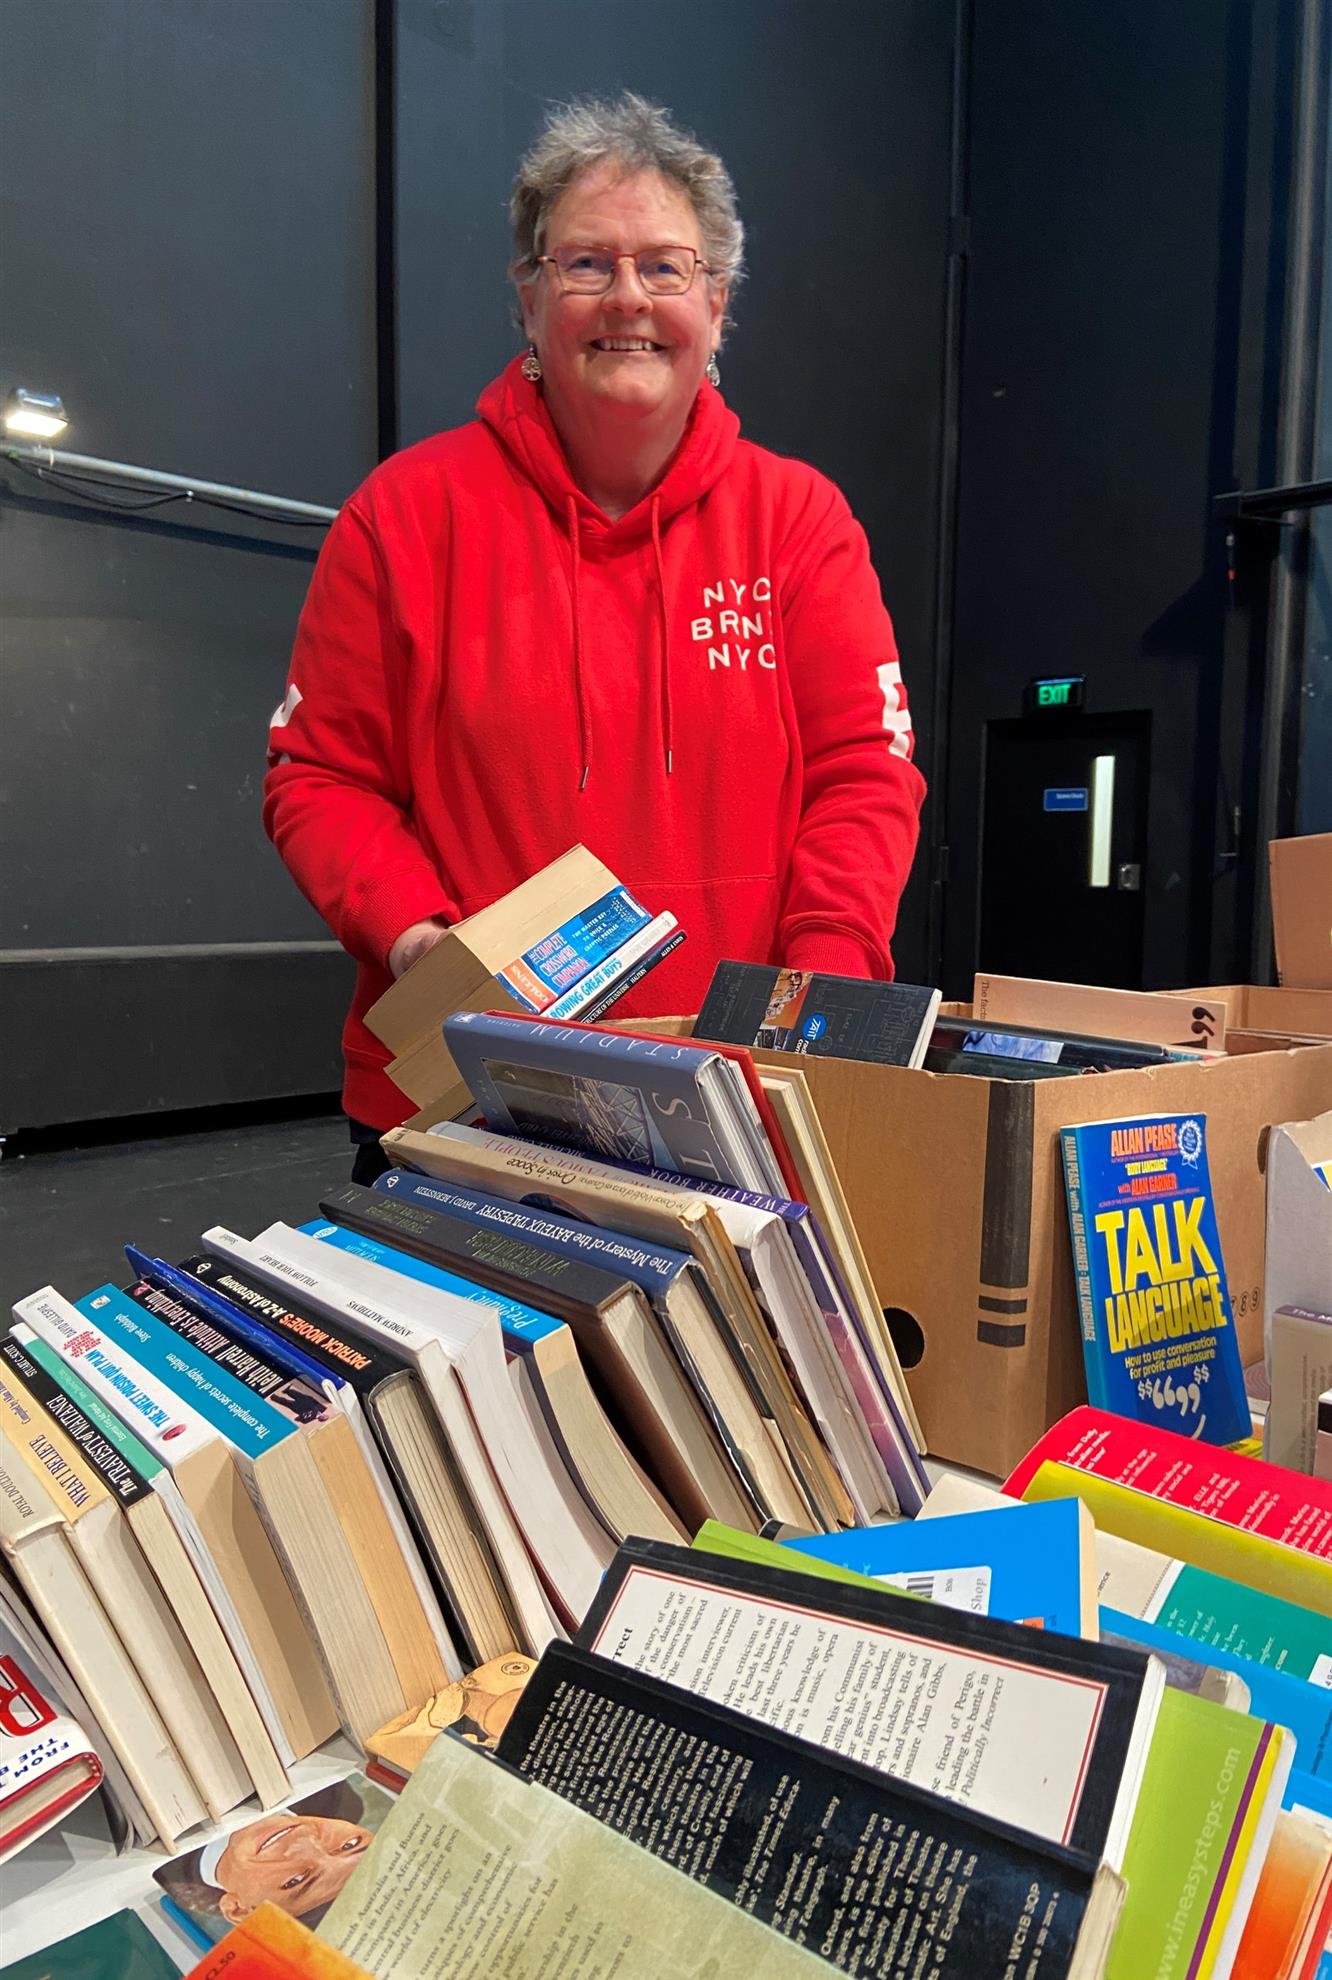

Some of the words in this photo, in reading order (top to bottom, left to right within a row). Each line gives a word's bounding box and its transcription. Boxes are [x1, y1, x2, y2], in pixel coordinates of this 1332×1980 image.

[703, 577, 771, 608] NYC
[690, 610, 773, 641] BRN
[708, 643, 776, 671] NYC
[1039, 683, 1072, 706] EXIT
[534, 933, 568, 960] COMPLETE
[511, 964, 549, 1003] COLLINS
[549, 990, 584, 1019] ROWING
[581, 974, 605, 996] GREAT
[583, 1006, 603, 1026] TRUCTURE
[525, 1023, 691, 1059] STADIUM
[1064, 1135, 1077, 1161] ALLAN
[1111, 1128, 1144, 1157] ALLAN
[1144, 1123, 1178, 1152] PEASE
[502, 1155, 538, 1175] Space
[532, 1164, 548, 1177] in
[643, 1168, 693, 1188] BOOK
[1067, 1161, 1080, 1188] PEASE
[412, 1185, 452, 1202] BERNSTEIN
[692, 1180, 779, 1211] WEATHER
[1118, 1183, 1131, 1194] with
[1131, 1177, 1149, 1195] ALAN
[1149, 1173, 1177, 1193] GARNER
[453, 1197, 477, 1210] DAVID
[1070, 1189, 1081, 1211] with
[474, 1203, 531, 1228] TAPESTRY
[1072, 1212, 1084, 1235] ALAN
[523, 1218, 575, 1242] BAYEUX
[568, 1232, 593, 1248] the
[583, 1236, 605, 1252] of
[598, 1240, 653, 1266] Mystery
[1075, 1236, 1088, 1271] GARNER
[1095, 1196, 1218, 1295] TALK
[258, 1254, 281, 1267] HEART
[275, 1263, 295, 1275] YOUR
[644, 1255, 676, 1274] The
[213, 1273, 266, 1304] Astronomy
[289, 1271, 318, 1286] FOLLOW
[1078, 1276, 1091, 1297] TALK
[36, 1302, 65, 1326] GILLESPIE
[138, 1285, 195, 1327] Everything
[251, 1297, 272, 1310] of
[345, 1300, 385, 1322] MATTHEWS
[457, 1288, 541, 1331] Pregnancy
[1105, 1274, 1228, 1354] LANGUAGE
[56, 1321, 77, 1338] DAVID
[111, 1310, 141, 1333] Biddulph
[174, 1314, 199, 1333] is
[276, 1312, 330, 1344] MOORE'S
[380, 1319, 413, 1337] ANDREW
[1081, 1297, 1096, 1342] LANGUAGE
[130, 1327, 151, 1343] Steve
[181, 1319, 230, 1356] Attitude
[83, 1348, 108, 1367] PLAN
[162, 1352, 190, 1374] children
[213, 1342, 261, 1377] Harrell
[319, 1337, 372, 1369] PATRICK
[1125, 1355, 1142, 1370] How
[1143, 1352, 1152, 1364] to
[1152, 1348, 1166, 1361] use
[1167, 1336, 1217, 1357] conversation
[1130, 1366, 1141, 1380] for
[1143, 1361, 1166, 1378] profit
[1166, 1357, 1181, 1371] and
[1182, 1348, 1216, 1369] pleasure
[15, 1357, 38, 1378] STUART
[95, 1358, 123, 1379] QUIT
[182, 1365, 209, 1387] happy
[242, 1363, 284, 1394] Keith
[107, 1372, 140, 1397] POISON
[197, 1380, 213, 1392] of
[205, 1386, 232, 1407] secrets
[44, 1392, 92, 1437] WAITANGI
[127, 1390, 159, 1416] SWEET
[223, 1399, 261, 1428] complete
[146, 1408, 172, 1427] THE
[250, 1422, 272, 1439] The
[75, 1428, 96, 1444] of
[27, 1433, 68, 1475] BELIEVE
[80, 1433, 132, 1483] TRAVESTY
[54, 1467, 71, 1480] I
[114, 1476, 138, 1496] The
[57, 1471, 93, 1507] WHAT
[10, 1493, 34, 1519] ROYAL
[969, 1577, 987, 1610] Shop
[631, 1653, 647, 1671] the
[641, 1626, 661, 1651] story
[655, 1611, 666, 1622] of
[661, 1591, 676, 1608] one
[647, 1646, 662, 1663] the
[657, 1609, 681, 1642] danger
[675, 1592, 687, 1604] of
[656, 1605, 694, 1669] conservatism
[675, 1632, 694, 1657] most
[687, 1599, 709, 1630] sacred
[697, 1605, 733, 1663] interviewer,
[695, 1644, 728, 1696] Television
[719, 1608, 743, 1644] current
[732, 1691, 747, 1708] He
[740, 1661, 761, 1688] leads
[754, 1641, 768, 1658] his
[761, 1617, 778, 1639] own
[748, 1679, 765, 1701] best
[758, 1620, 792, 1672] libertarian
[826, 1704, 840, 1721] his
[833, 1638, 865, 1703] Communist
[953, 1668, 978, 1710] Perigo,
[864, 1722, 879, 1746] into
[872, 1649, 906, 1721] broadcasting
[880, 1696, 905, 1742] Lindsay
[897, 1669, 913, 1693] tells
[906, 1652, 918, 1666] of
[915, 1703, 933, 1732] Alan
[926, 1661, 947, 1699] Gibbs,
[551, 1749, 567, 1774] with
[562, 1730, 576, 1750] the
[571, 1690, 596, 1732] ancient
[948, 1714, 961, 1729] of
[17, 1736, 58, 1763] THE
[961, 1733, 991, 1797] Politically
[979, 1676, 1007, 1732] Incorrect
[12, 1740, 69, 1778] FROM
[934, 1734, 955, 1771] friend
[613, 1786, 638, 1827] drama.
[632, 1761, 647, 1783] Her
[643, 1721, 668, 1758] survey
[638, 1730, 690, 1827] pre-revolutionary
[859, 1811, 880, 1842] from
[846, 1844, 868, 1874] also
[837, 1875, 858, 1903] and
[388, 1935, 413, 1970] world
[408, 1920, 421, 1935] of
[415, 1866, 456, 1921] electricity
[816, 1904, 849, 1956] Oxford,
